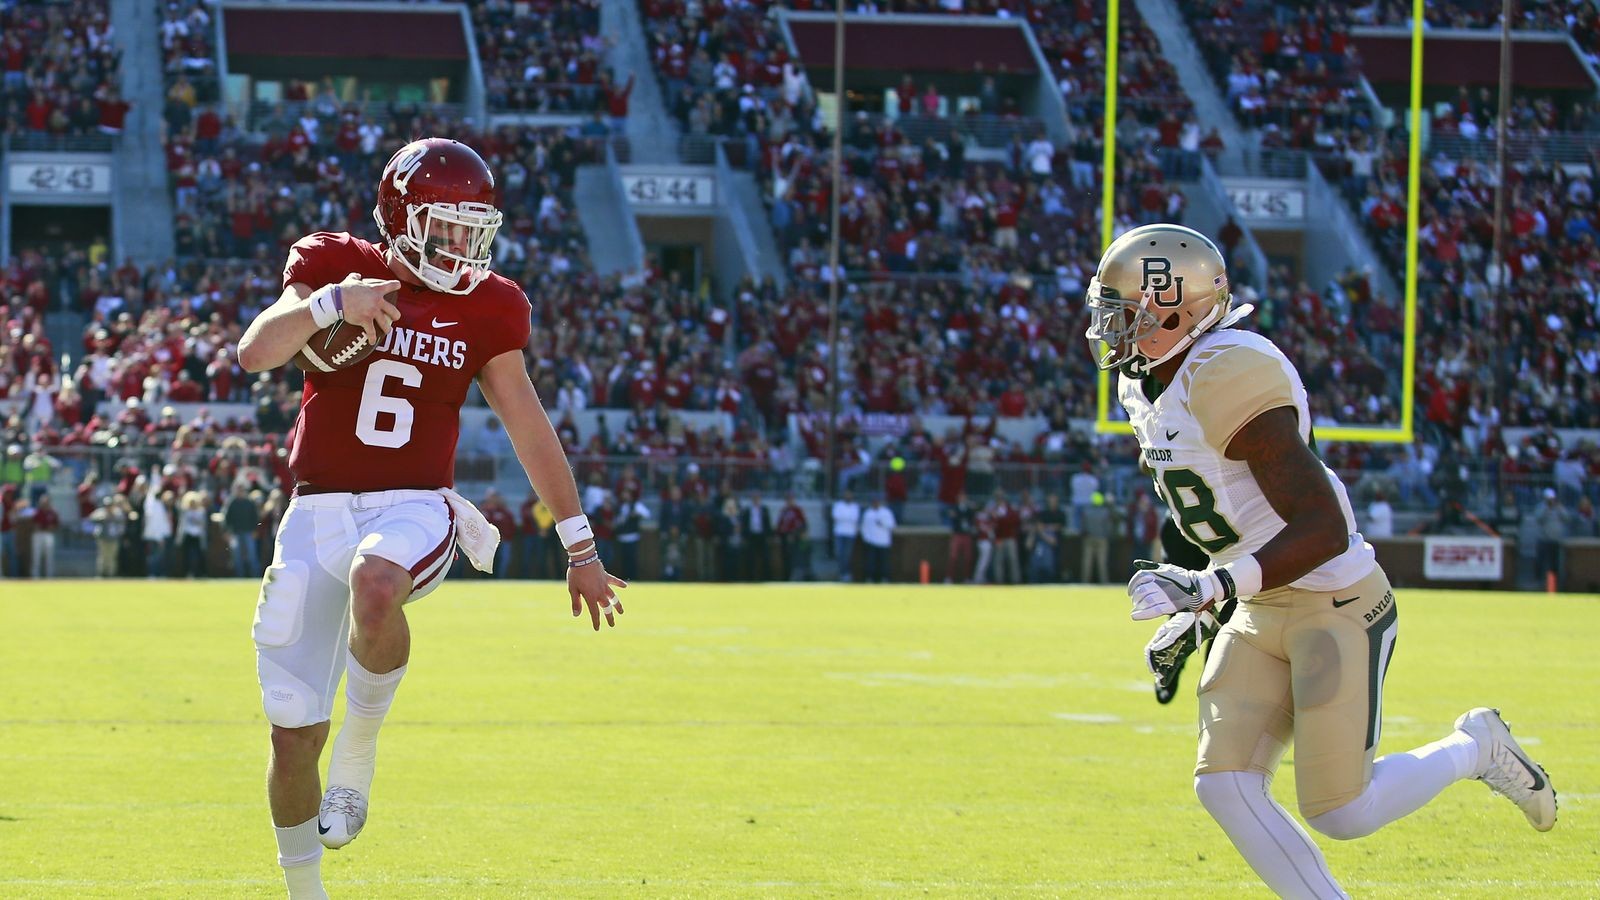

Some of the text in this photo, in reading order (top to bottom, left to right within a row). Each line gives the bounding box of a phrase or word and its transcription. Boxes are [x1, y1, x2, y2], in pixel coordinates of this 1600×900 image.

[1140, 256, 1184, 308] BU
[376, 326, 467, 370] ONERS
[355, 358, 423, 449] 6
[1143, 447, 1173, 462] AYLOR
[1431, 544, 1495, 564] ESPN
[1363, 590, 1394, 623] BAYLOR
